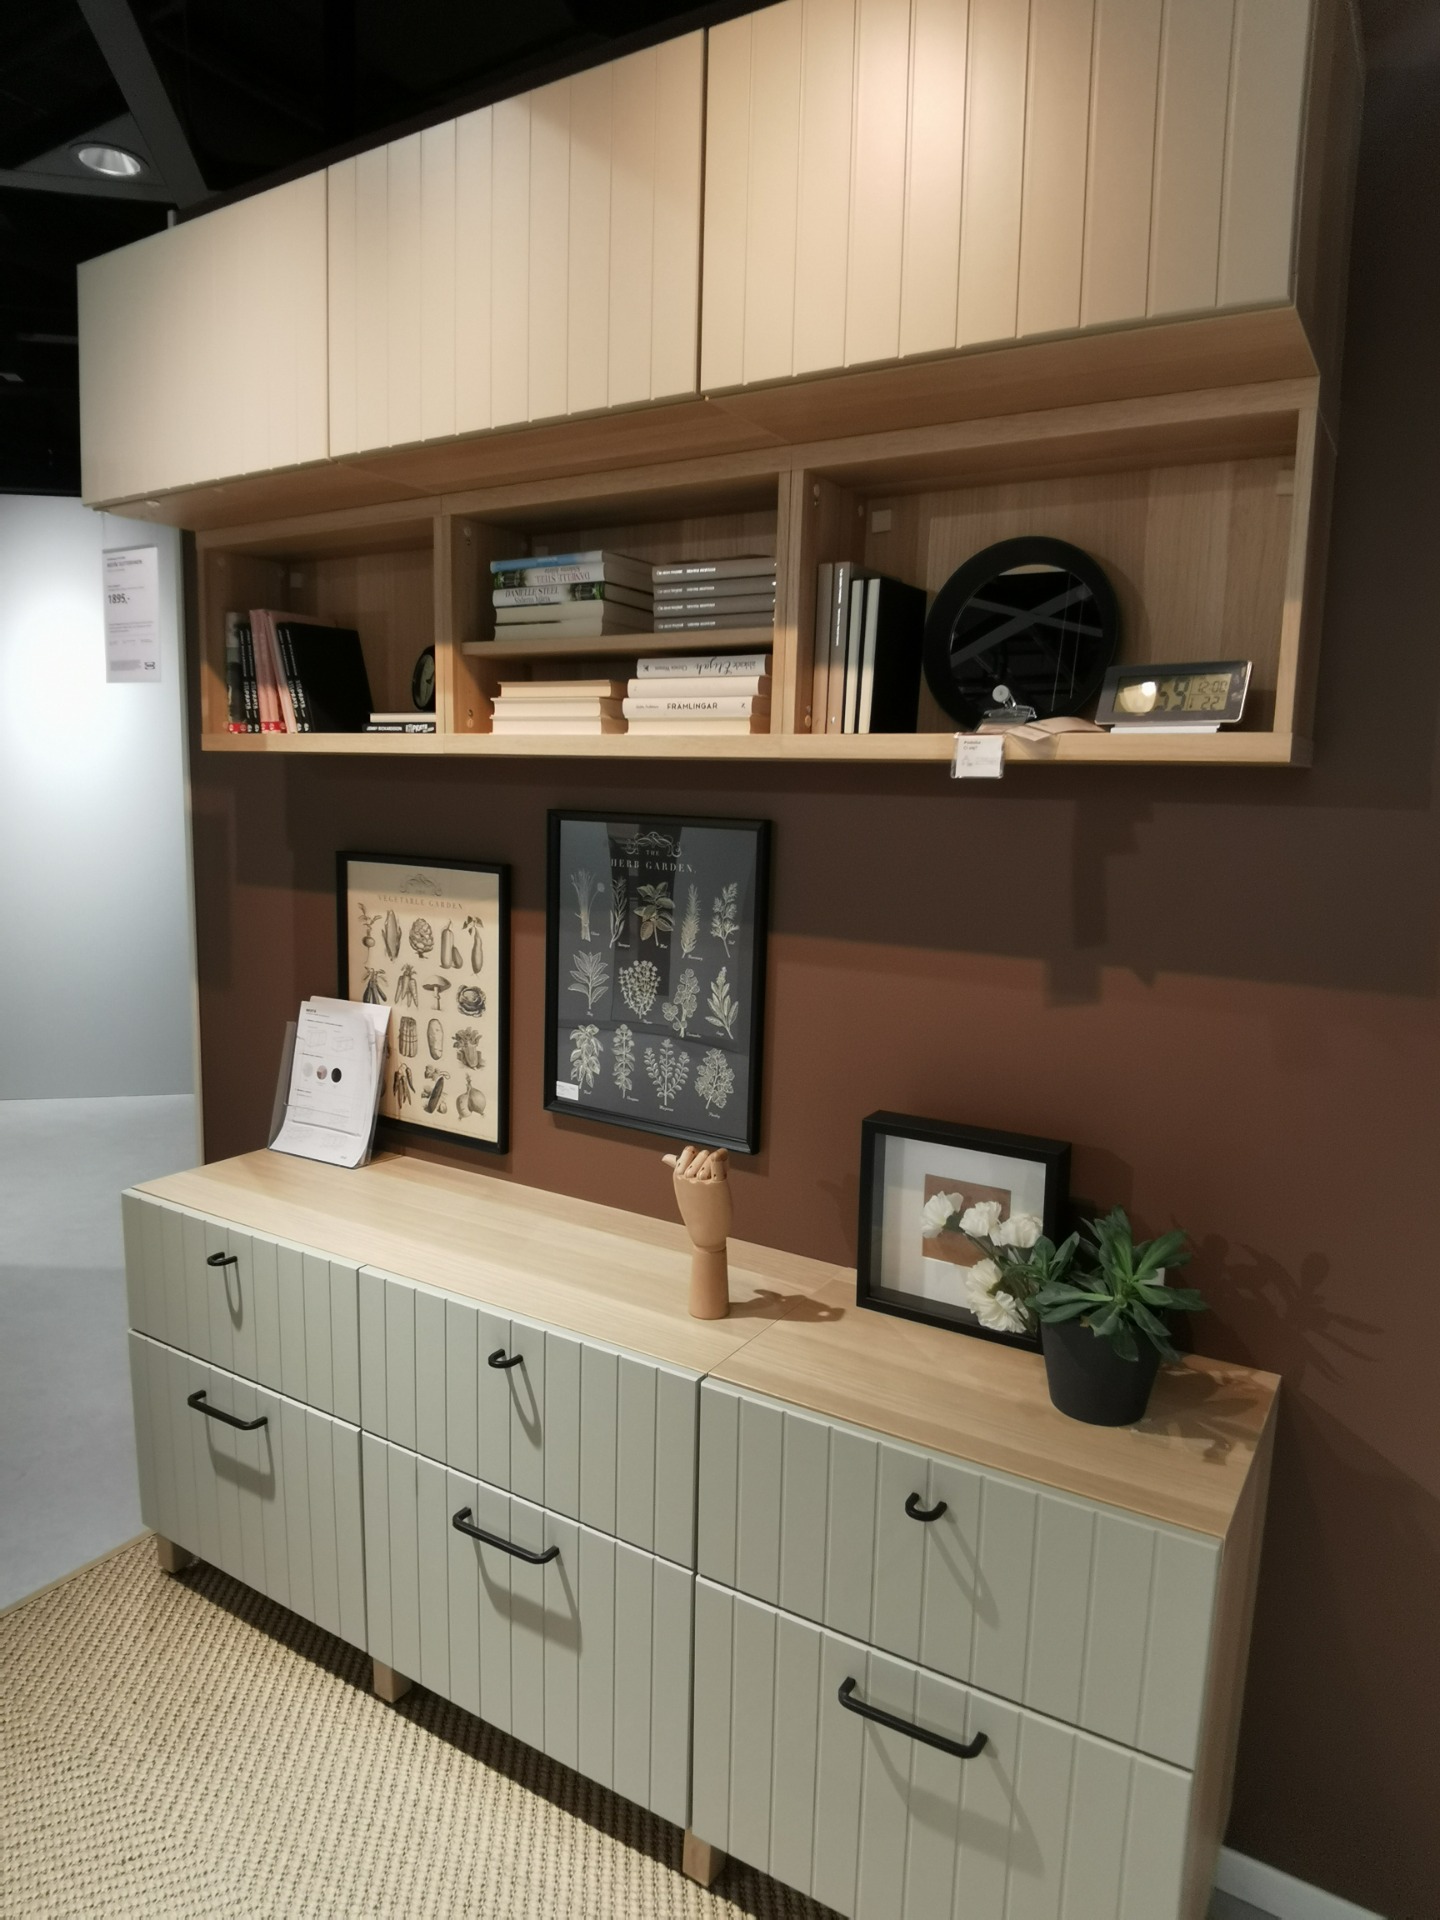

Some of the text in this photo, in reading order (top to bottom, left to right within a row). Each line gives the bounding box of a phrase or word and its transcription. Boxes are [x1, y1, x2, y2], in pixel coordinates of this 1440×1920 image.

[611, 858, 640, 869] HERB
[377, 894, 463, 910] VEGETABLE GARDEN
